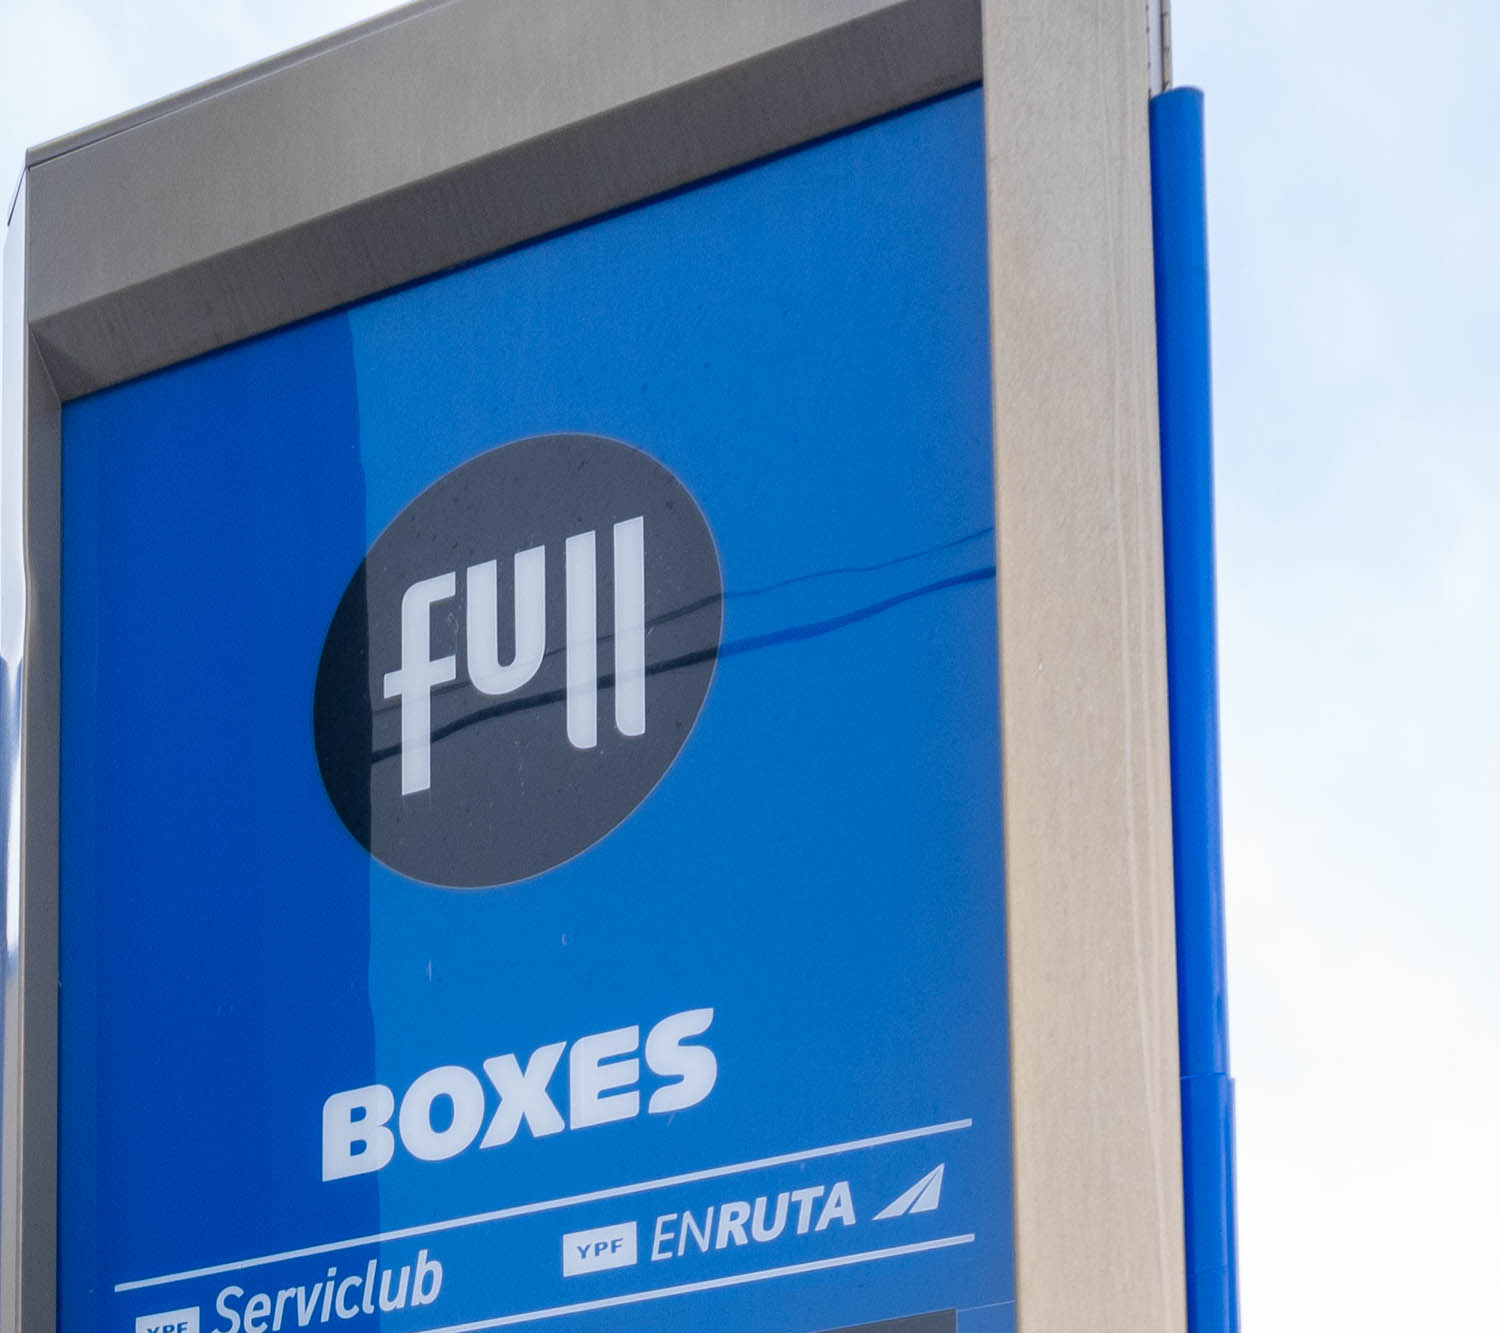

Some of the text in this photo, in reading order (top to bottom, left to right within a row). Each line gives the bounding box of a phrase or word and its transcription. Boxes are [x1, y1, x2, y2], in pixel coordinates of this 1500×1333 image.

[383, 515, 647, 797] full
[321, 1007, 719, 1183] BOXES
[577, 1237, 624, 1260] YPF
